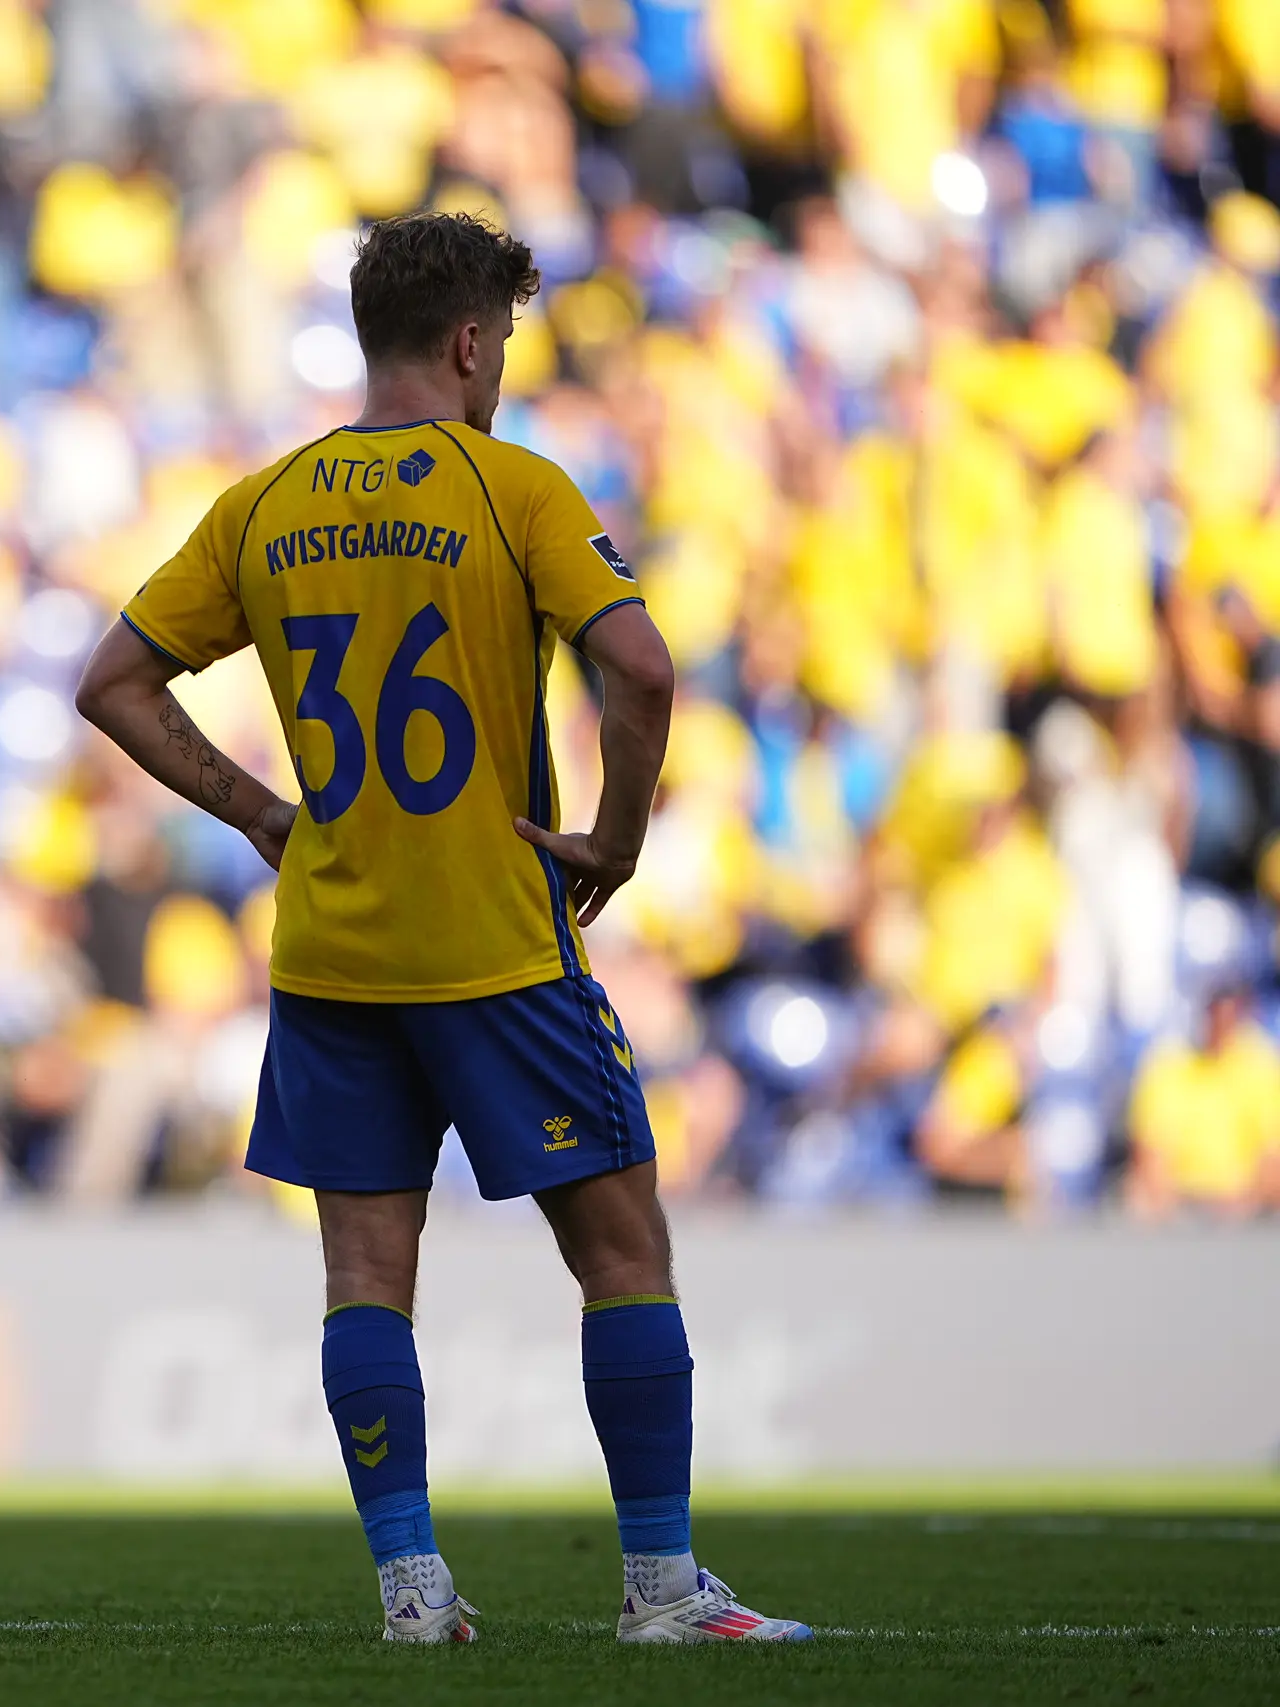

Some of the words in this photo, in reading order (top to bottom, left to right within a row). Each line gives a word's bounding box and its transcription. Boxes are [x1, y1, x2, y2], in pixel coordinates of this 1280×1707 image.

[311, 458, 384, 493] NTG
[265, 520, 468, 576] KVISTGAARDEN
[280, 602, 476, 825] 36
[543, 1136, 578, 1152] hummel
